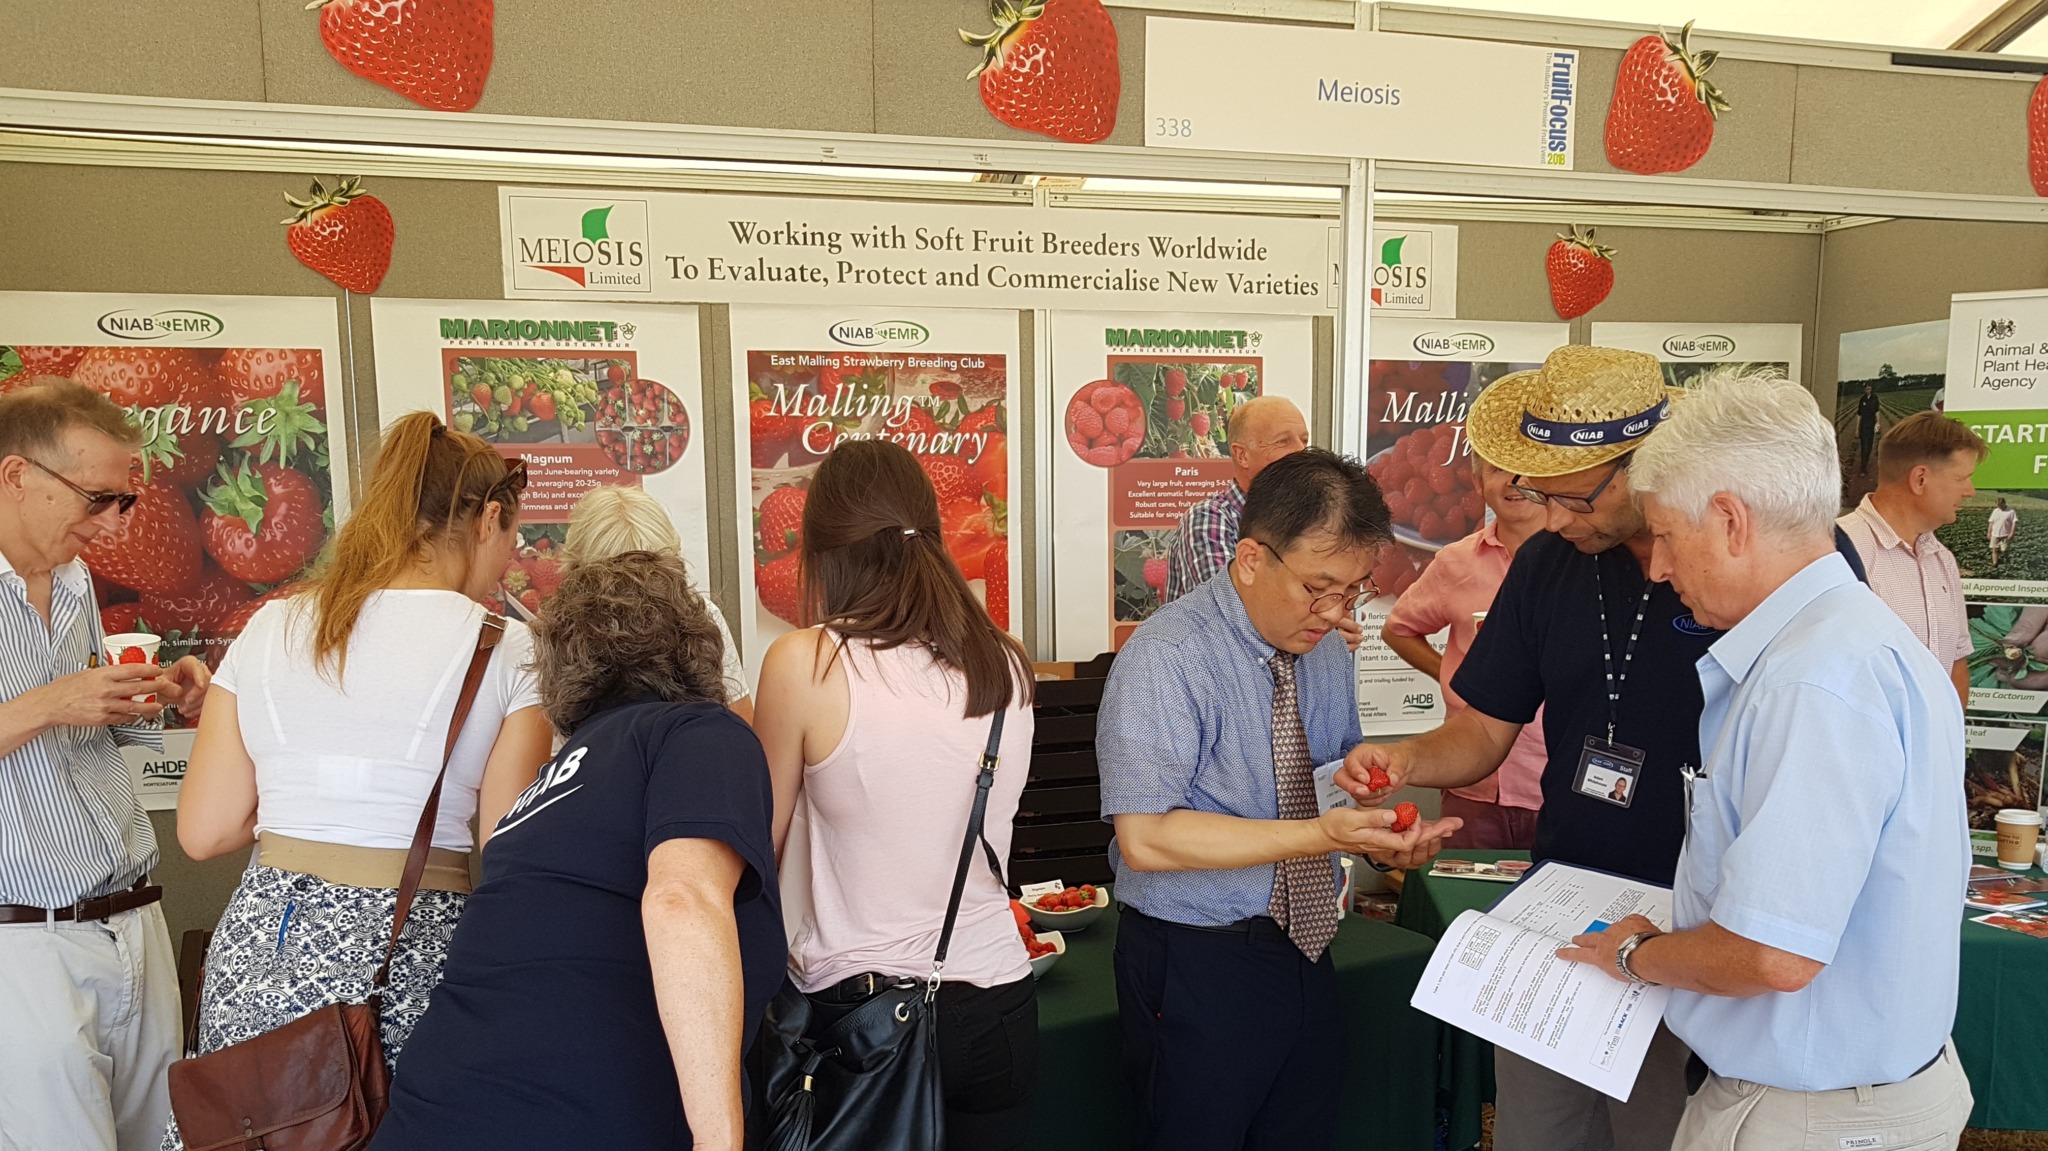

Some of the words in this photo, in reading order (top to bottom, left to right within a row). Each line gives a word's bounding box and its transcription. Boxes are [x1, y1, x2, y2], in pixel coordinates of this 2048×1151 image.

[1317, 79, 1401, 106] Meiosis
[1548, 52, 1575, 153] FruitFocus
[1541, 101, 1549, 131] Premier
[1154, 117, 1193, 138] 338
[728, 220, 842, 254] Working
[850, 225, 907, 250] with
[915, 227, 964, 251] Soft
[972, 229, 1035, 254] Fruit
[1042, 231, 1140, 258] Breeders
[1148, 235, 1268, 261] Worldwide
[518, 237, 644, 267] MEIOSIS
[589, 271, 642, 286] Limited
[665, 255, 699, 281] To
[708, 257, 829, 287] Evaluate,
[836, 260, 928, 285] Protect
[935, 264, 980, 287] and
[987, 265, 1160, 291] Commercialise
[1168, 270, 1219, 293] New
[1226, 272, 1320, 296] Varieties
[1384, 292, 1424, 305] Limited
[109, 317, 154, 331] NIAB
[172, 318, 212, 332] EMR
[440, 318, 616, 342] MARIONNET
[839, 326, 874, 339] NIAB
[888, 328, 919, 340] EMR
[1105, 328, 1247, 348] MARIONNET
[1421, 338, 1450, 349] NIAB
[1461, 339, 1487, 350] EMR
[1669, 340, 1696, 351] NIAB
[1706, 341, 1729, 351] EMR
[1984, 343, 2034, 357] Animal
[771, 355, 796, 366] East
[799, 355, 840, 369] Malling
[843, 356, 905, 370] Strawberry
[908, 357, 957, 370] Breeding
[960, 358, 985, 368] Club
[1983, 360, 2020, 372] Plant
[2025, 358, 2048, 371] Hea
[1980, 376, 2037, 391] Agency
[766, 383, 915, 427] Malling
[1379, 391, 1467, 423] Malli
[122, 405, 278, 446] egance
[1528, 425, 1550, 438] NIAB
[1627, 419, 1649, 432] NIAB
[1575, 430, 1604, 440] NIAB
[520, 453, 573, 466] Magnum
[2033, 455, 2048, 474] F
[544, 468, 593, 477] June-bearing
[594, 468, 620, 477] variety
[1174, 467, 1199, 476] Paris
[1137, 480, 1151, 488] Very
[1152, 480, 1168, 488] large
[520, 491, 531, 499] gh
[532, 491, 549, 499] Brix)
[1973, 583, 2016, 592] Approved
[2018, 584, 2048, 593] Inspect
[1368, 611, 1388, 620] florica
[172, 638, 202, 647] similar
[205, 637, 215, 645] to
[217, 637, 236, 647] Sym
[1402, 693, 1434, 705] AHDB
[1969, 690, 1990, 698] hora
[1992, 691, 2035, 700] Cactorum
[1970, 728, 1987, 736] leaf
[142, 760, 188, 774] AHDB
